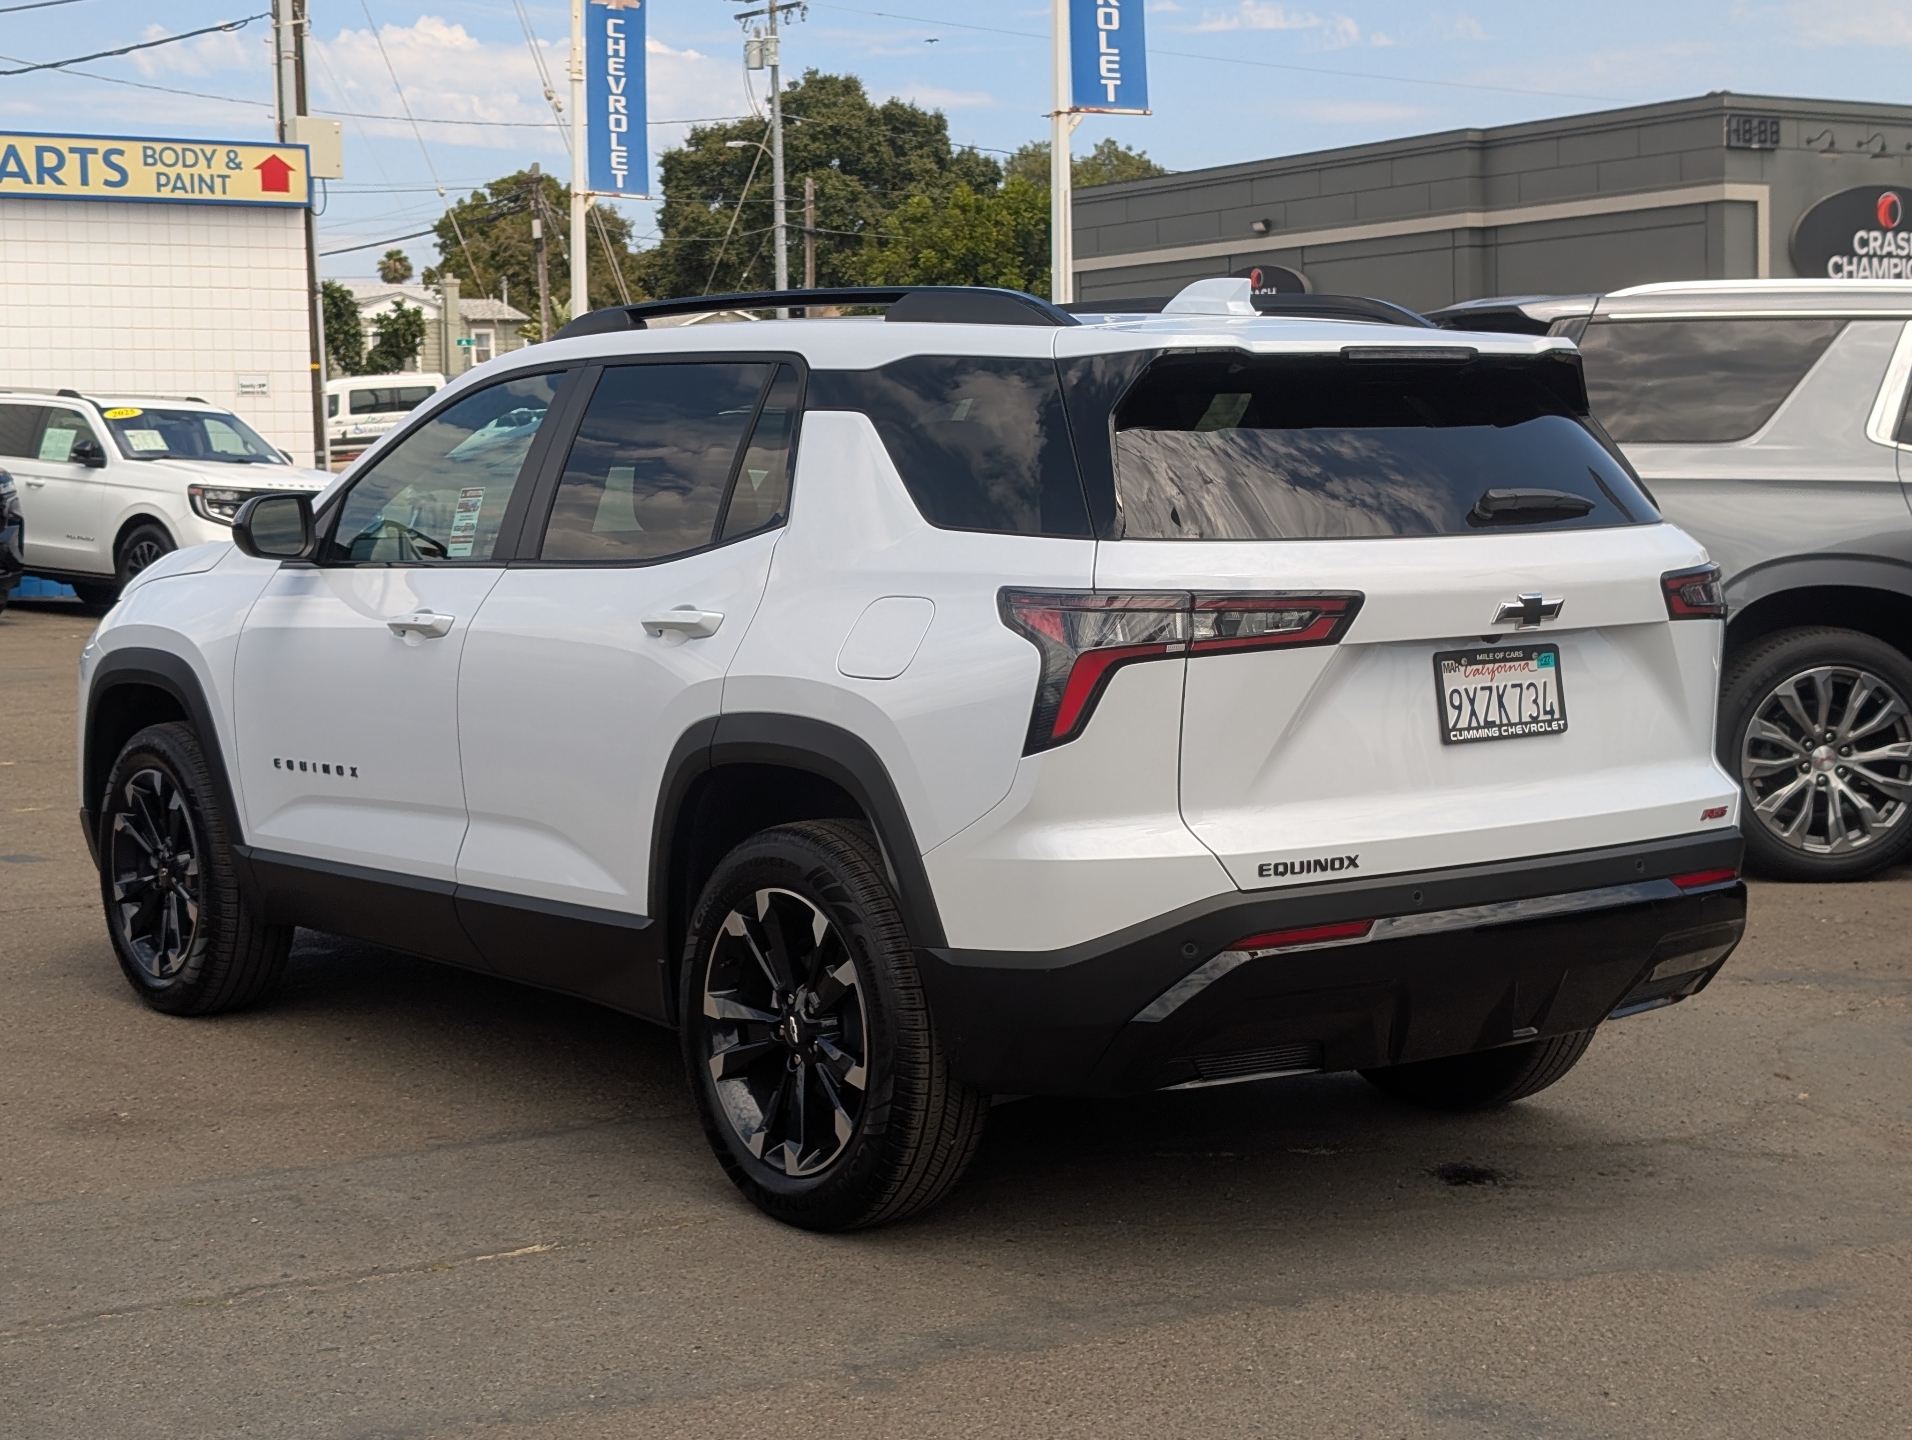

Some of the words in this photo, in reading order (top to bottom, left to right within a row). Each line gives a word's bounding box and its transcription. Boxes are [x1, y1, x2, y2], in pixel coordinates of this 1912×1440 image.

[1096, 0, 1121, 102] OLET
[606, 18, 629, 189] CHEVROLET
[0, 144, 129, 188] ARTS
[142, 146, 217, 169] BODY
[225, 149, 243, 171] &
[155, 171, 231, 195] PAINT
[1853, 229, 1912, 256] CRAS
[112, 409, 135, 418] 2025
[1442, 661, 1460, 674] MAR
[1476, 653, 1494, 661] MILE
[1494, 651, 1504, 660] OF
[1505, 650, 1524, 658] CARS
[1463, 661, 1537, 683] California
[1449, 680, 1555, 729] 9XZK734
[1450, 727, 1499, 741] CUMMING
[1501, 720, 1565, 736] CHEVROLET
[273, 758, 358, 778] EQUINOX
[1700, 805, 1729, 821] RS
[1257, 854, 1360, 878] EQUINOX
